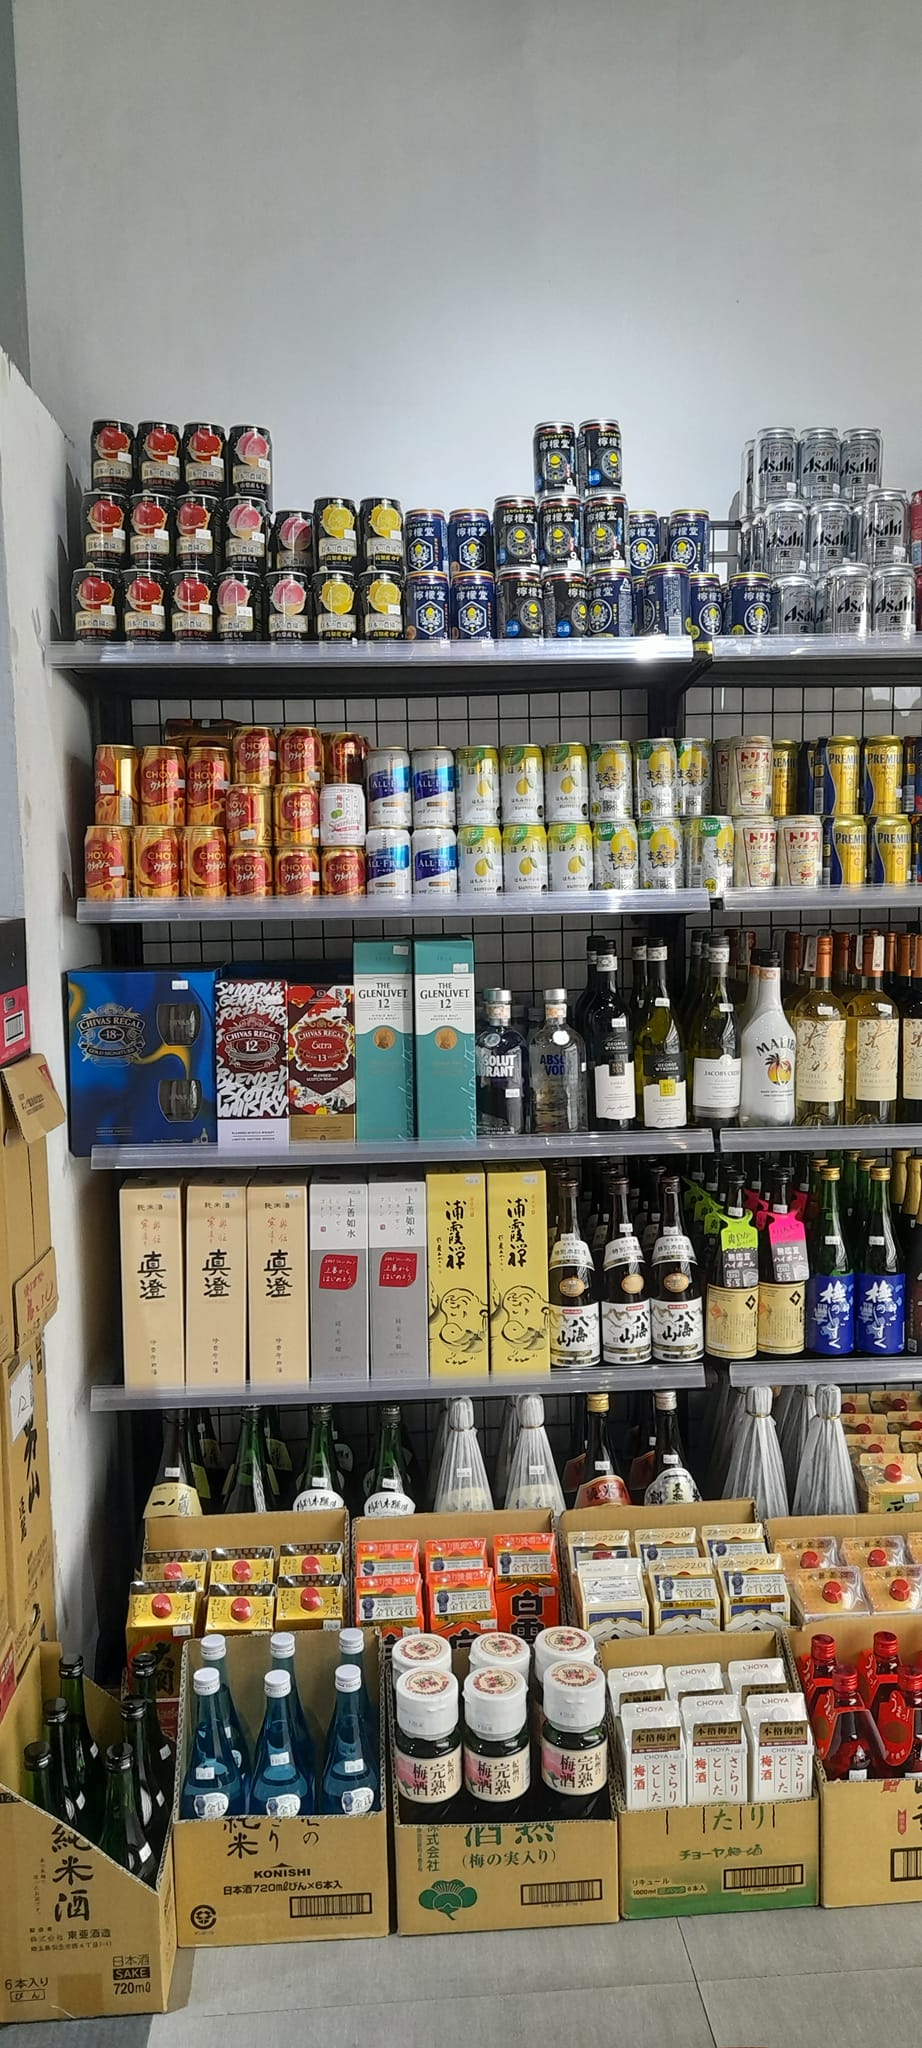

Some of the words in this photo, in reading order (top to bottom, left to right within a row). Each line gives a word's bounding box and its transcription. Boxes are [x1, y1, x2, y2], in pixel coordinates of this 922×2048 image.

[758, 457, 794, 474] Asahi
[803, 456, 839, 474] Asahi
[840, 457, 877, 476] Asahi
[864, 520, 901, 538] Asahi
[767, 531, 803, 548] Asahi
[813, 532, 849, 547] Asahi
[241, 743, 270, 751] CHOYA
[284, 743, 313, 751] CHOYA
[741, 752, 769, 762] トリス
[145, 771, 178, 780] CHOYA
[189, 771, 222, 780] CHOYA
[287, 800, 316, 808] CHOYA
[790, 831, 820, 842] トリス
[233, 864, 263, 872] CHOYA
[280, 864, 311, 872] CHOYA
[329, 864, 359, 872] CHOYA
[358, 989, 408, 999] GLENLIVET
[420, 989, 470, 999] GLENLIVET
[378, 999, 390, 1009] 12
[440, 999, 452, 1009] 12
[79, 1017, 111, 1030] CHIVAS
[113, 1017, 141, 1030] REGAL
[226, 1030, 252, 1042] CHIVAS
[254, 1030, 277, 1041] REGAL
[298, 1030, 321, 1041] CHIVAS
[324, 1030, 345, 1041] REGAL
[245, 1040, 259, 1051] 12
[312, 1040, 332, 1049] Extra
[756, 1038, 796, 1056] MALIB
[318, 1054, 327, 1062] 13
[217, 1067, 287, 1086] BLENDED
[222, 1082, 285, 1102] SCOTCH
[218, 1098, 288, 1117] WHISKY
[346, 1198, 356, 1238] 上善如水
[405, 1195, 415, 1236] 上善如水
[137, 1251, 167, 1300] 真澄
[202, 1249, 231, 1298] 真澄
[264, 1250, 293, 1298] 真澄
[622, 1670, 648, 1678] CHOYA
[680, 1668, 706, 1676] CHOYA
[697, 1699, 724, 1707] CHOYA
[636, 1733, 676, 1743] 本格梅酒
[697, 1727, 738, 1736] 本格梅酒
[763, 1727, 804, 1736] 本格梅酒
[560, 1755, 575, 1789] 梅酒
[577, 1755, 594, 1789] 完熟
[695, 1758, 707, 1784] 梅酒
[760, 1755, 773, 1781] 梅酒
[778, 1755, 788, 1793] とした
[795, 1755, 805, 1793] さらり
[413, 1763, 428, 1796] 梅酒
[430, 1763, 446, 1795] 完熟
[477, 1763, 492, 1796] 梅酒
[494, 1762, 511, 1795] 完熟
[634, 1765, 646, 1791] 梅酒
[652, 1764, 662, 1802] とした
[668, 1763, 678, 1802] さらり
[713, 1757, 723, 1796] とした
[730, 1756, 740, 1796] さらり
[713, 1809, 733, 1830] た
[462, 1849, 557, 1869] (梅の実入り)
[680, 1844, 763, 1861] チョーヤ梅酒
[254, 1868, 311, 1879] KONISHI
[632, 1878, 669, 1886] リキュール
[68, 1929, 111, 1940] 東亜酒造
[113, 1954, 149, 1967] 日本酒
[115, 1968, 148, 1979] SAKE
[5, 1977, 49, 1990] 6本入り
[15, 1992, 40, 2001] びん
